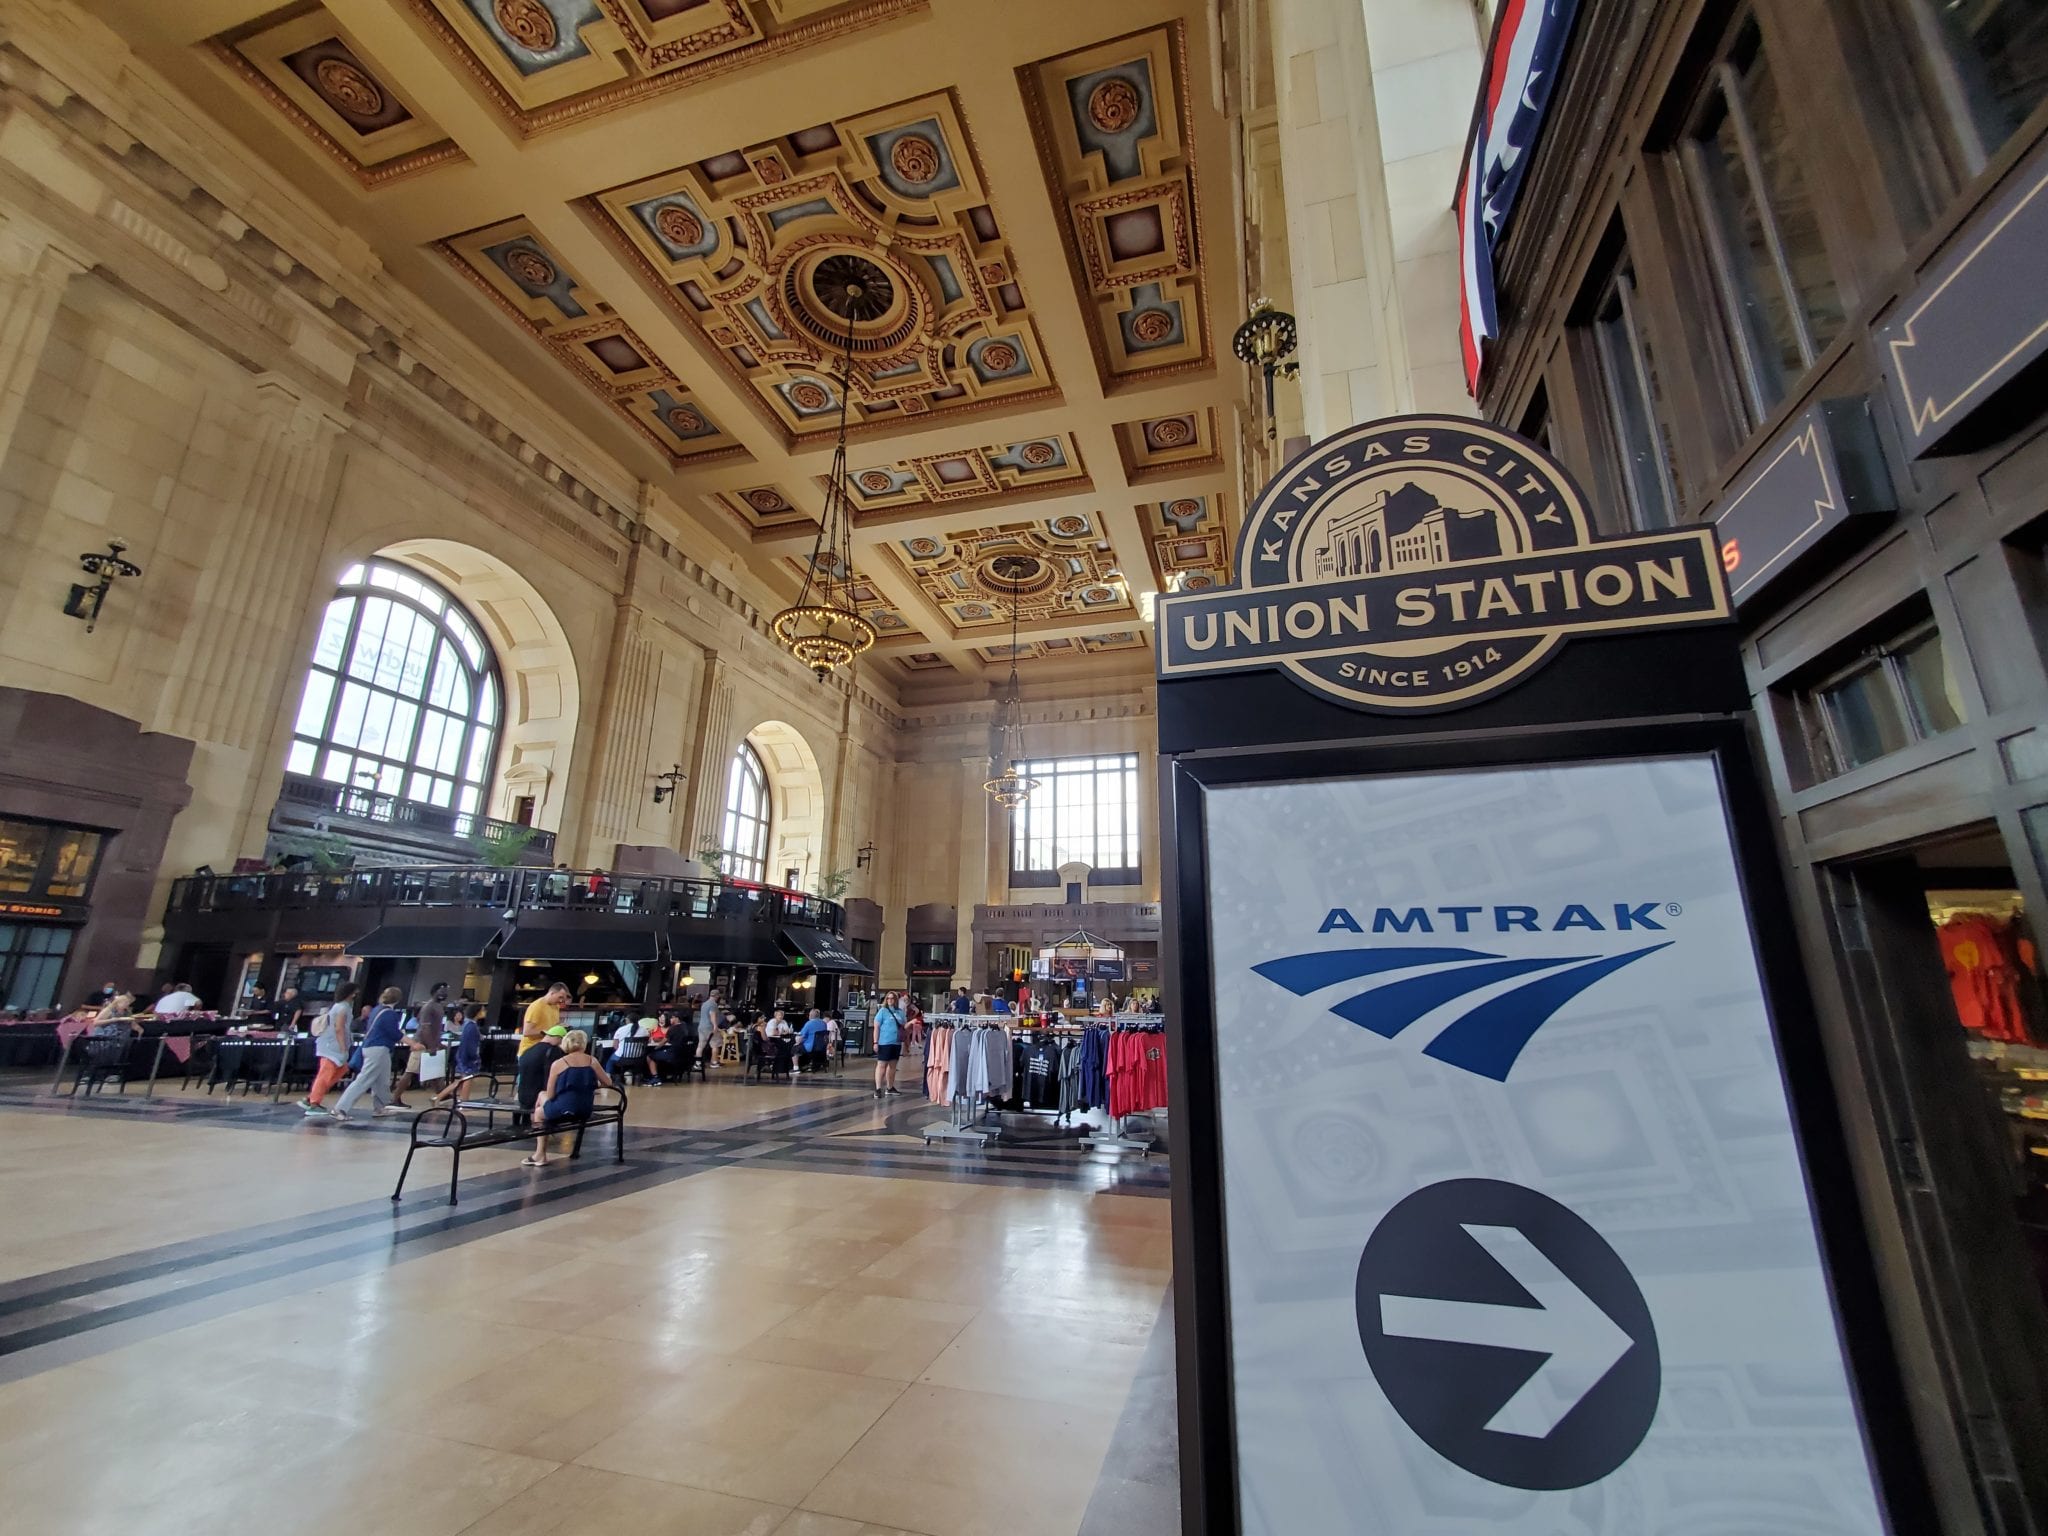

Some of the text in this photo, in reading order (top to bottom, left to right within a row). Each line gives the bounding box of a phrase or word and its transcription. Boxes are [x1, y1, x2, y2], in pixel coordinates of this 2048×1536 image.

[1261, 436, 1563, 562] KANSAS CITY
[1183, 556, 1692, 650] UNION STATION
[1338, 647, 1502, 687] SINCE 1914
[11, 906, 62, 915] STORIES
